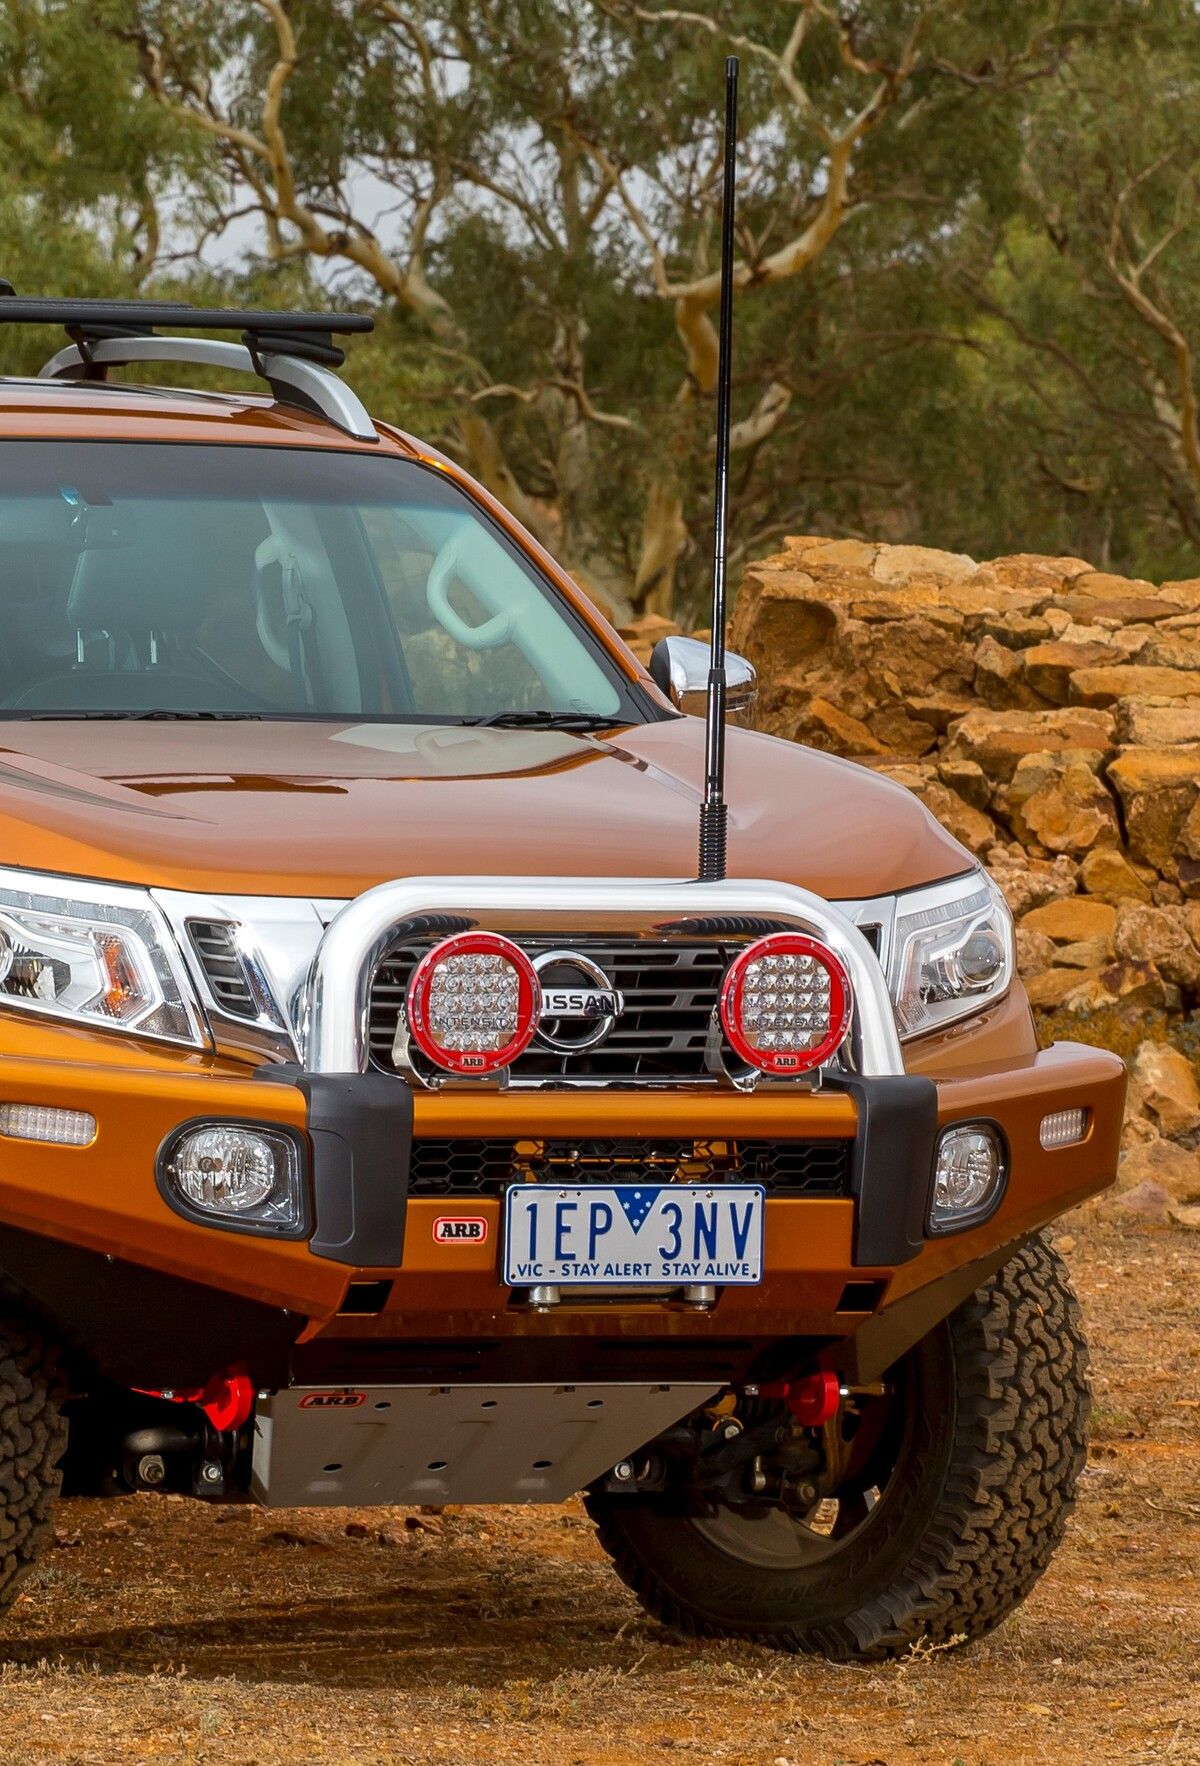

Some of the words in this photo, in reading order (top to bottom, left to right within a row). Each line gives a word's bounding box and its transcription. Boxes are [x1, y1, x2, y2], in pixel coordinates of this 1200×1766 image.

[542, 994, 615, 1010] ISSAN
[434, 1017, 518, 1028] INTENSITY
[746, 1018, 829, 1028] INTENSITY
[462, 1057, 484, 1067] ARB
[775, 1058, 797, 1066] ARB
[440, 1223, 481, 1238] ARB
[526, 1202, 613, 1261] 1EP
[658, 1202, 754, 1261] 3NV
[516, 1263, 543, 1277] VIC
[561, 1263, 600, 1277] STAY
[603, 1263, 652, 1277] ALERT
[661, 1263, 701, 1277] STAY
[704, 1263, 750, 1277] ALIVE
[307, 1396, 359, 1406] ARB
